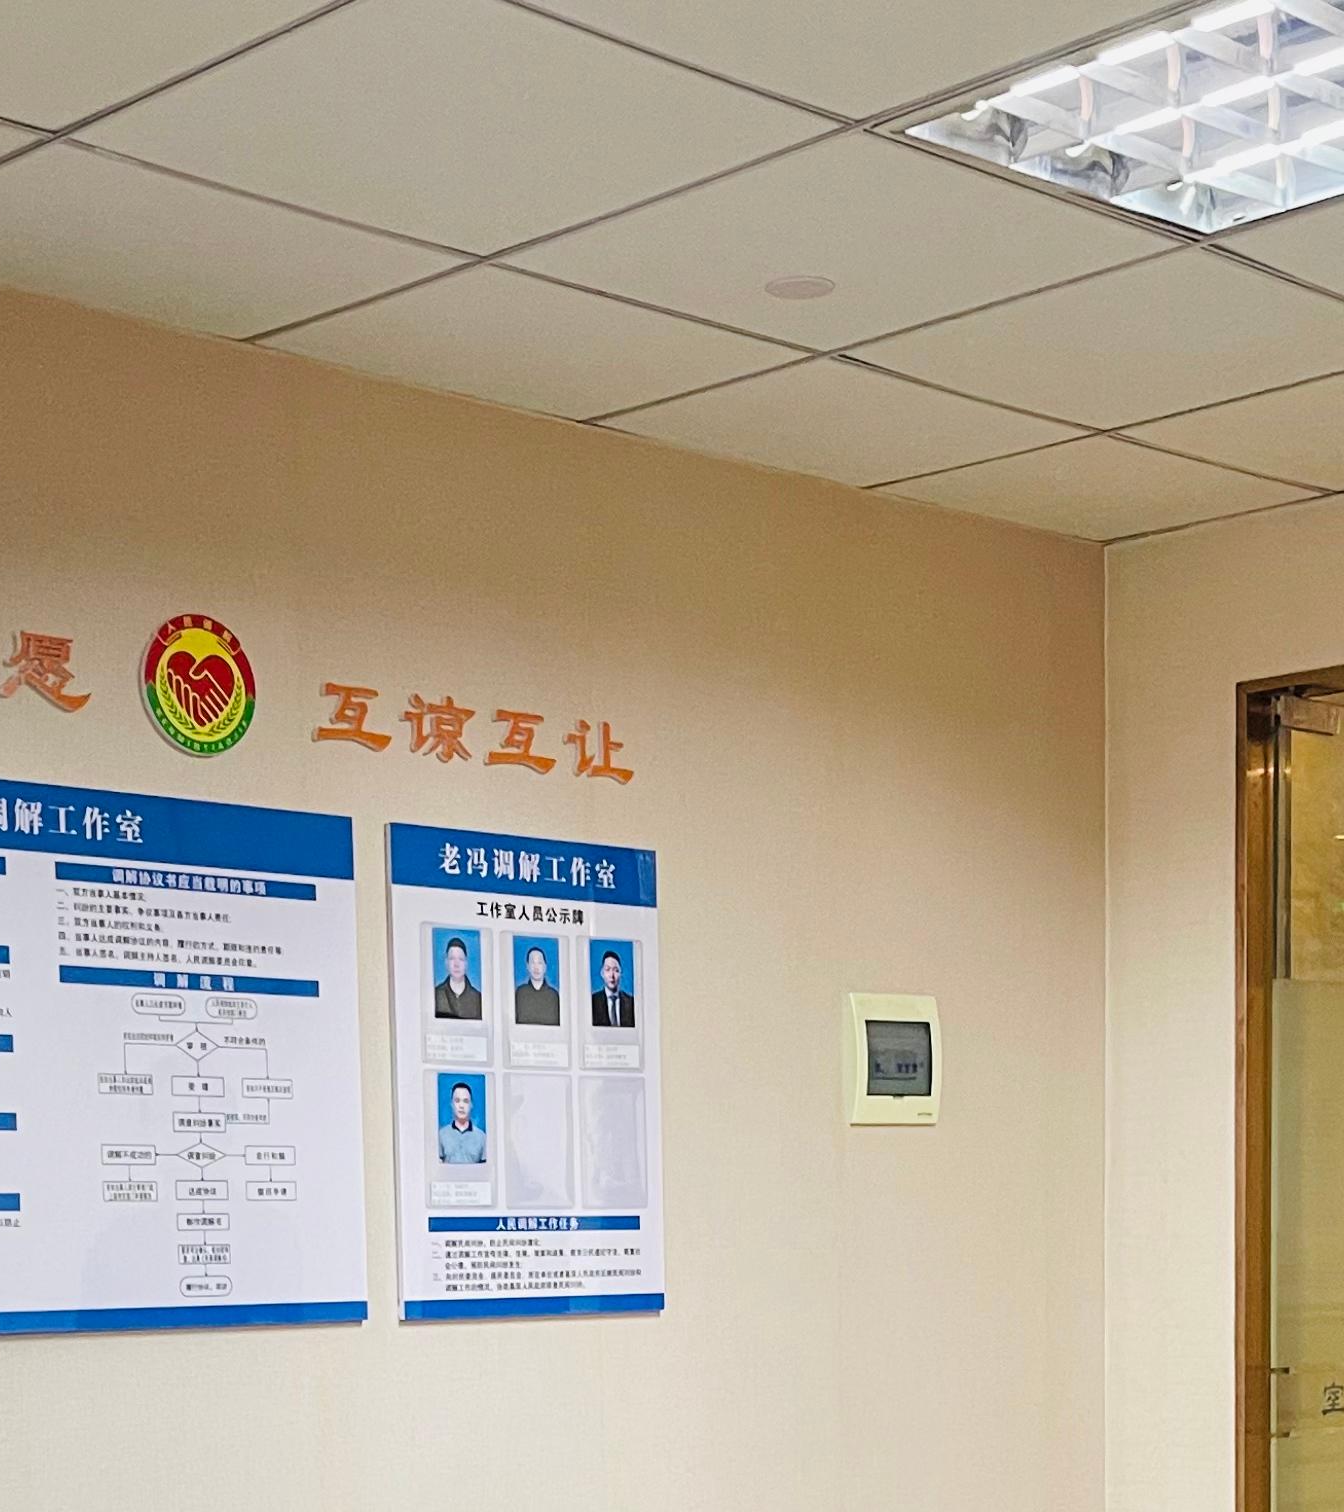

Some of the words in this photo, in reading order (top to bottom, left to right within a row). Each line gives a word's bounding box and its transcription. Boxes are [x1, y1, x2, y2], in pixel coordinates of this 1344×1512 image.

[311, 682, 634, 785] 互谅互让
[438, 842, 617, 889] 老冯调解工作室
[476, 901, 584, 925] 工作室人员公示牌
